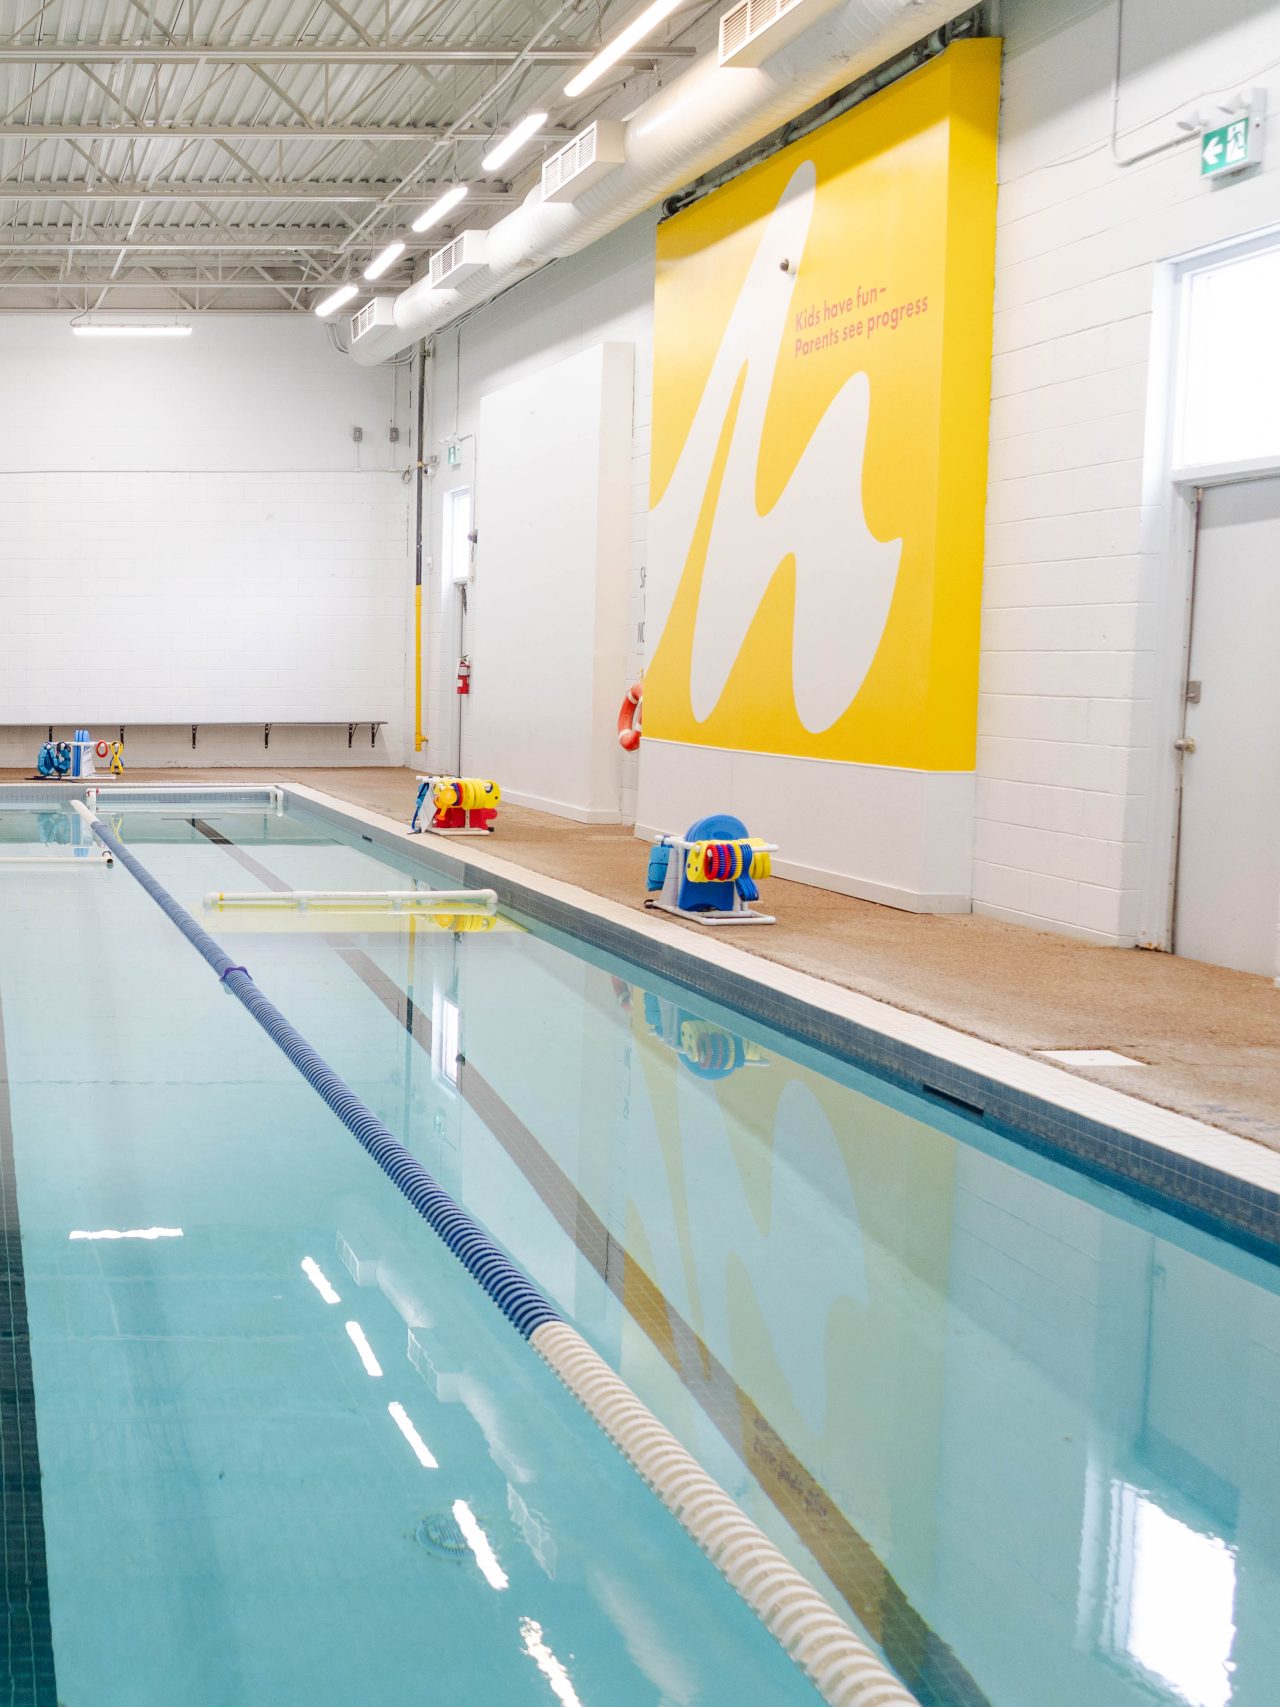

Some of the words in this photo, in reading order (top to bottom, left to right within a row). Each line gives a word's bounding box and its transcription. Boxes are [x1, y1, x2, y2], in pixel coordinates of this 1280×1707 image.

[795, 305, 820, 332] Kids
[824, 297, 853, 322] have
[795, 328, 839, 358] Parents
[842, 320, 863, 342] see
[867, 296, 928, 339] progress
